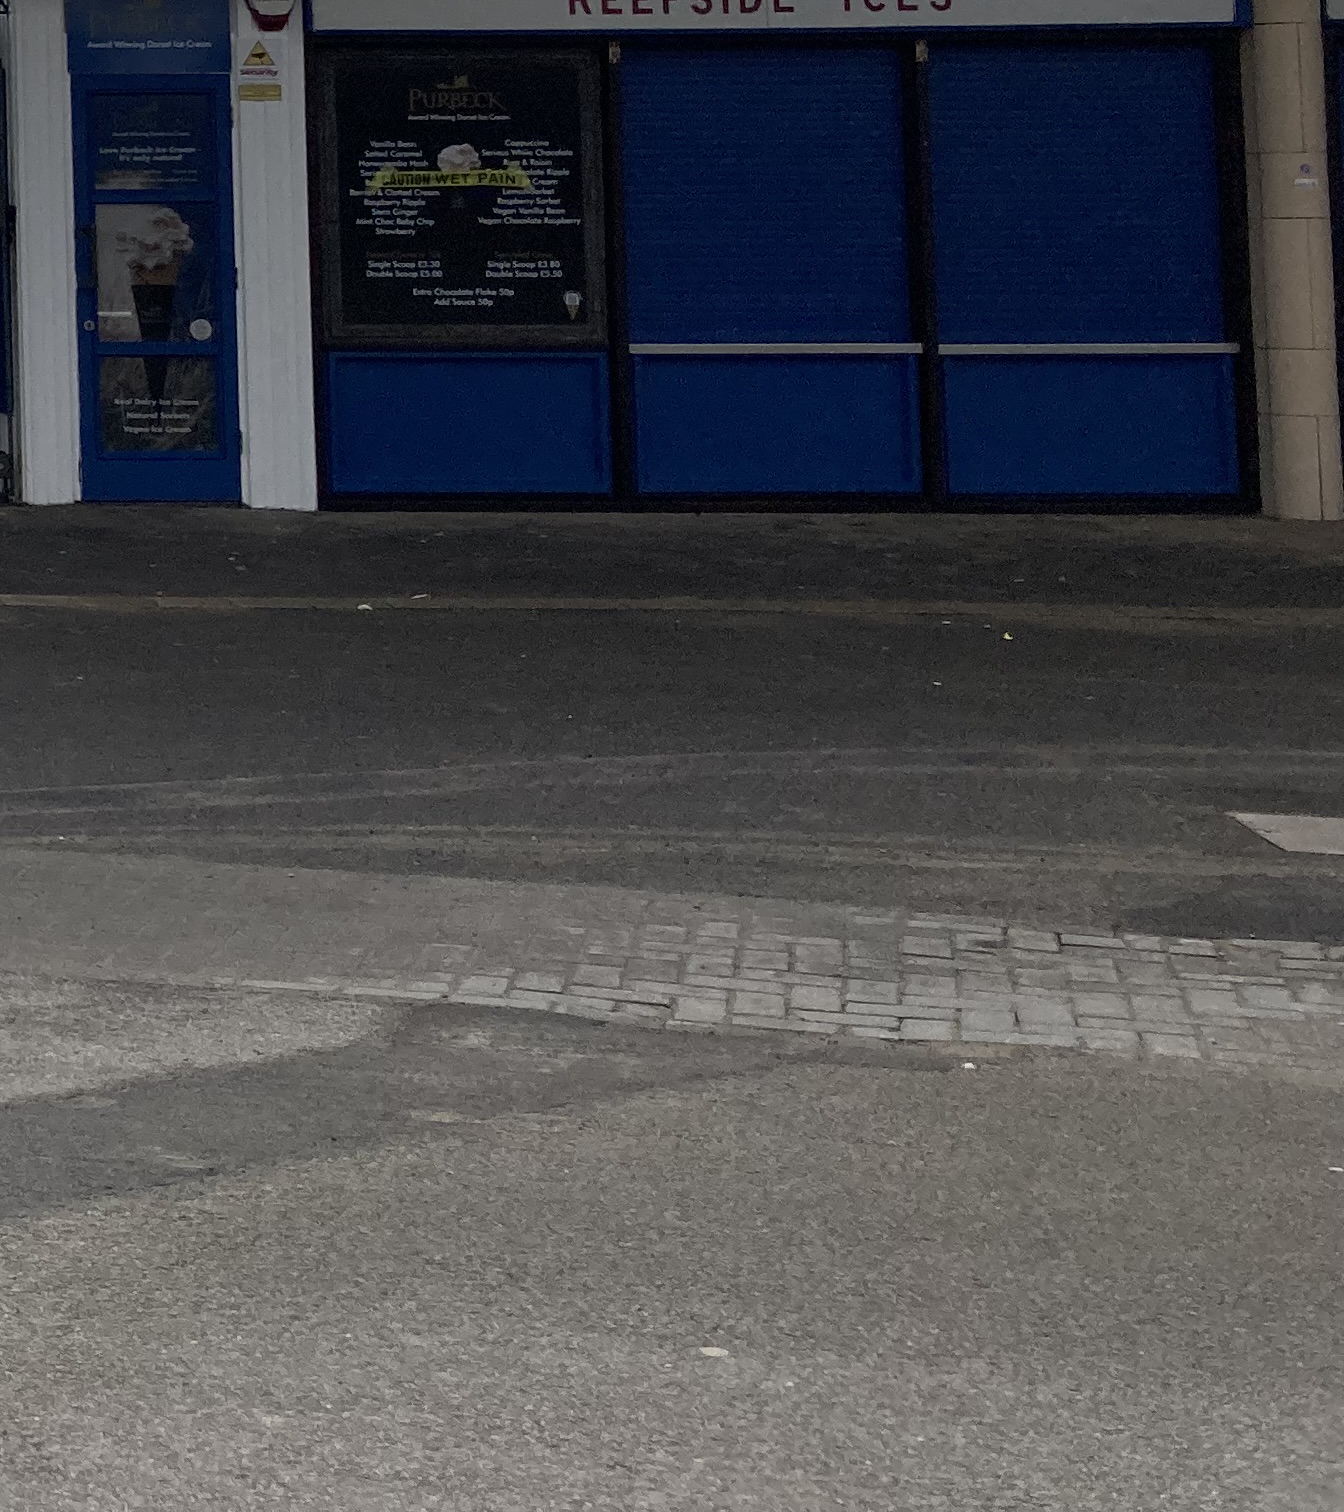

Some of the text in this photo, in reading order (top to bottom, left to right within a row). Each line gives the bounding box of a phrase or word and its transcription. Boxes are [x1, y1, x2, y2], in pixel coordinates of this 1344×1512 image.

[408, 88, 509, 112] PURBECK
[382, 172, 431, 185] CAUTION
[435, 171, 472, 185] WET
[433, 298, 450, 306] Add
